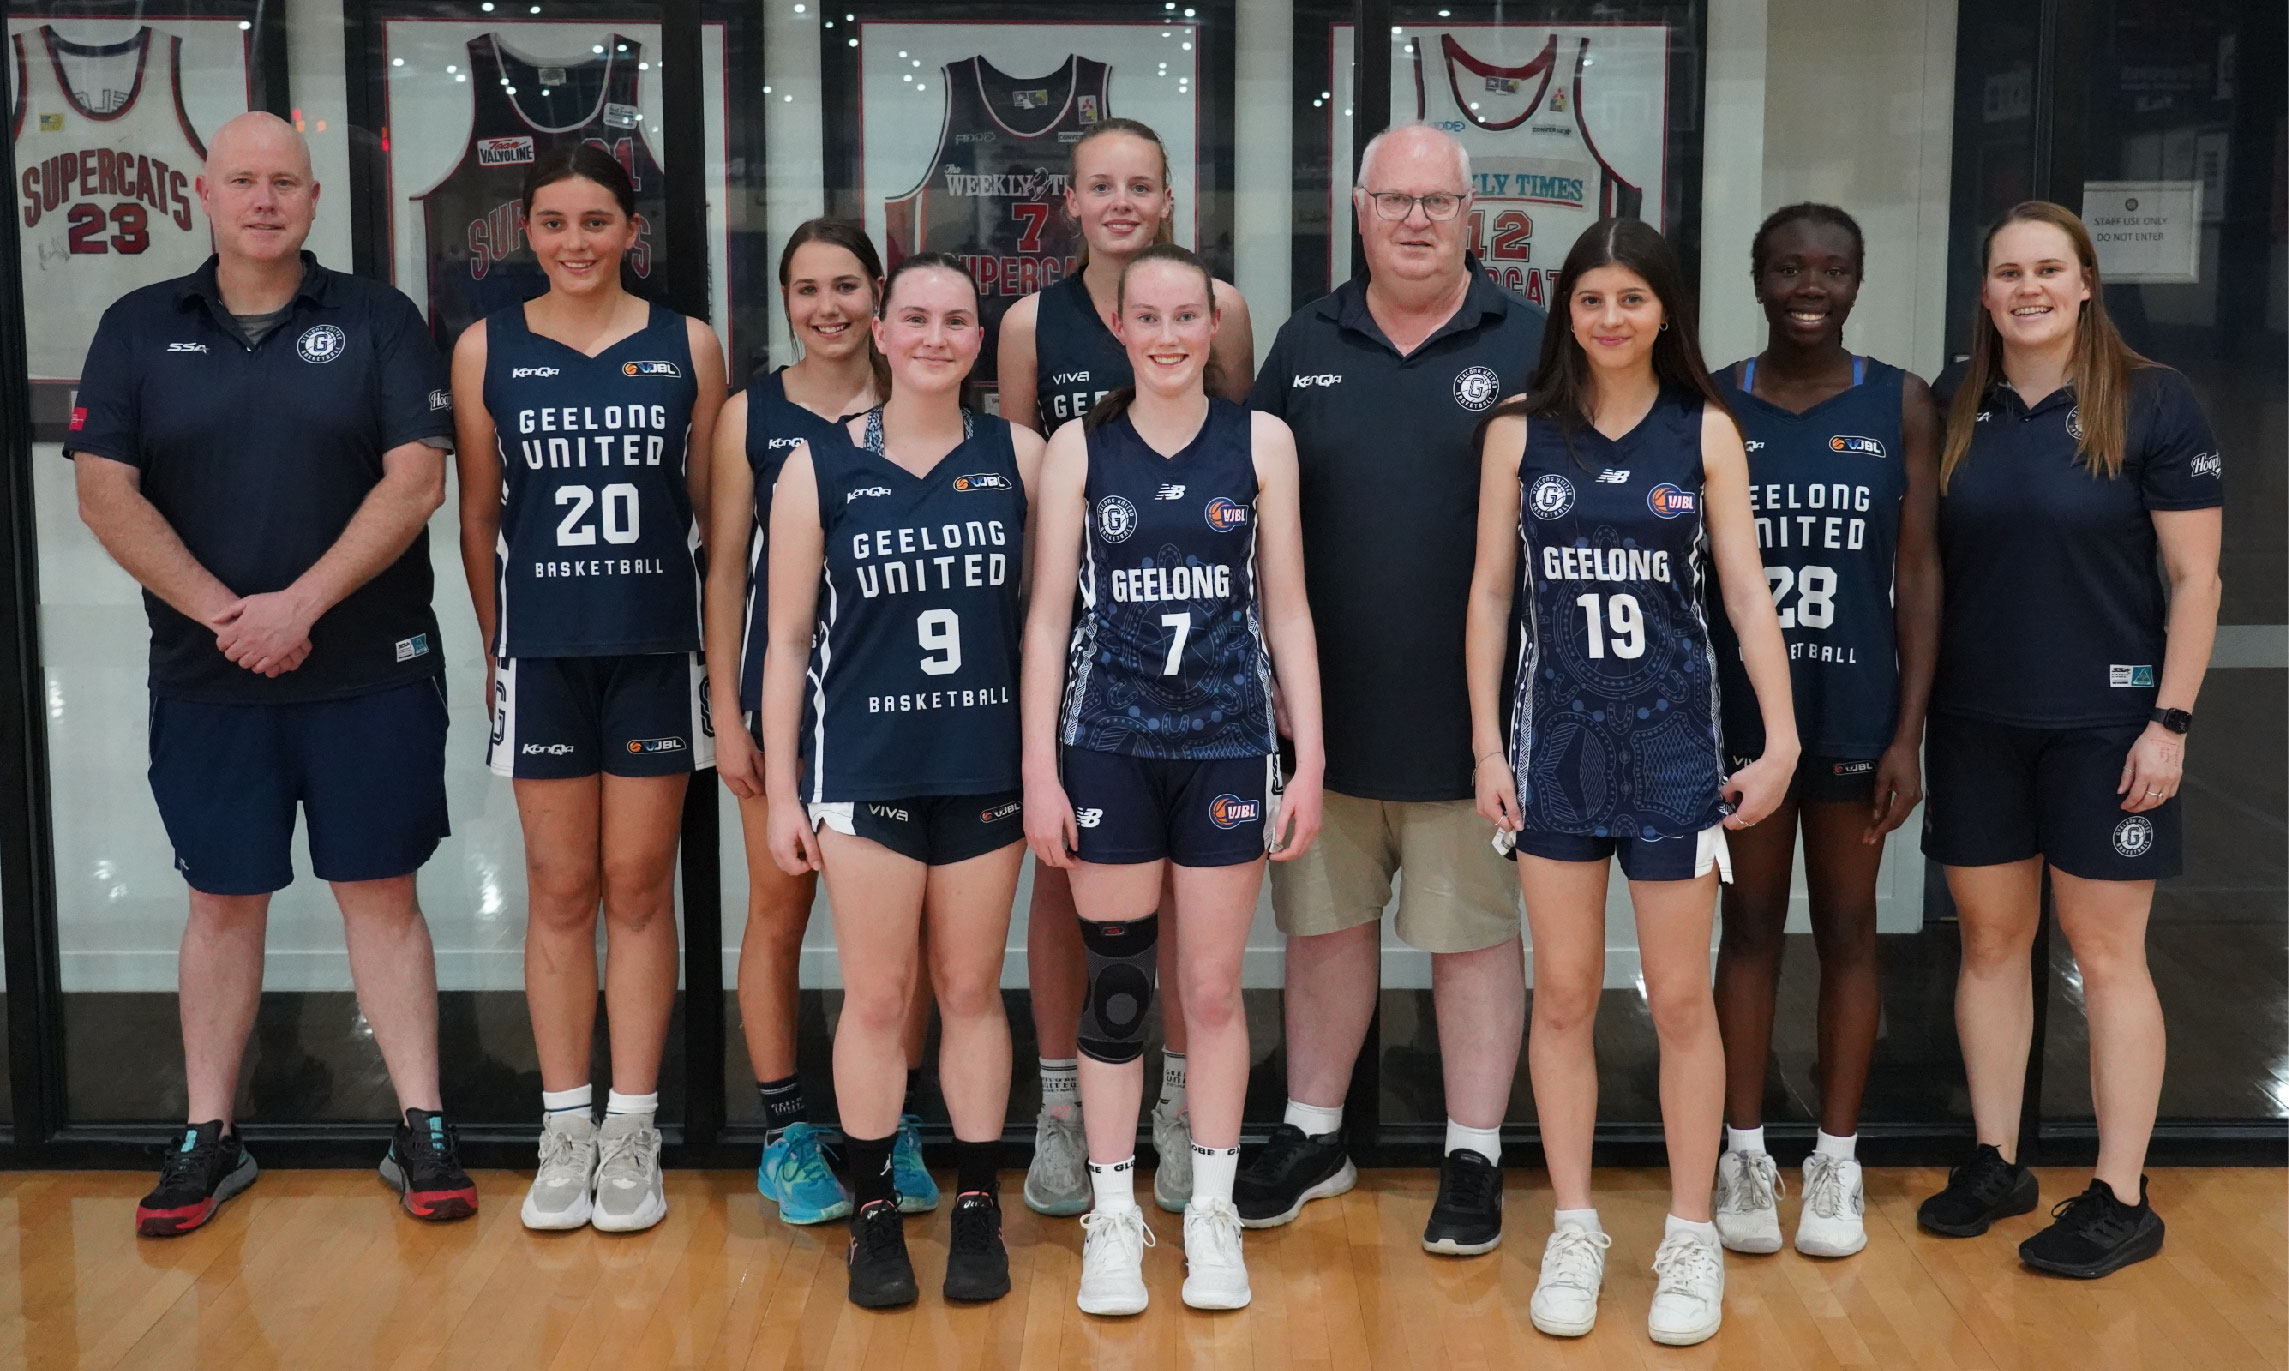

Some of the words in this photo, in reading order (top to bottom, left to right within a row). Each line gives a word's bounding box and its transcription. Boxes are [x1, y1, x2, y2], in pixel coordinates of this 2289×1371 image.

[480, 145, 534, 164] VALVOLINE
[945, 164, 961, 174] The
[22, 147, 192, 231] SUPERCATS
[945, 173, 1033, 196] WEEKLY
[1515, 174, 1583, 201] TIMES
[68, 202, 150, 255] 23
[1011, 202, 1048, 252] 7
[1467, 210, 1533, 262] 12
[2094, 217, 2122, 226] STAFF
[2123, 217, 2140, 226] USE
[2143, 217, 2168, 226] ONLY
[2097, 233, 2111, 242] DO
[2113, 233, 2132, 241] NOT
[2135, 232, 2164, 241] ENTER
[519, 404, 666, 434] GEELONG
[522, 434, 664, 470] UNITED
[554, 482, 640, 547] 20
[1668, 495, 1694, 510] VJBL
[1749, 483, 1870, 512] EELONG
[1223, 508, 1246, 522] VJBL
[853, 520, 1006, 560] GEELONG
[1754, 516, 1866, 550] NITED
[535, 558, 664, 578] BASKETBALL
[856, 553, 1006, 598] UNITED
[1543, 546, 1671, 584] GEELONG
[1112, 564, 1230, 602] GEELONG
[1767, 565, 1838, 629] 28
[917, 608, 962, 676] 9
[1576, 592, 1646, 659] 19
[1161, 612, 1191, 676] 7
[869, 686, 1009, 713] BASKETBALL
[1227, 803, 1256, 820] VJBL
[1191, 1144, 1215, 1156] OBE
